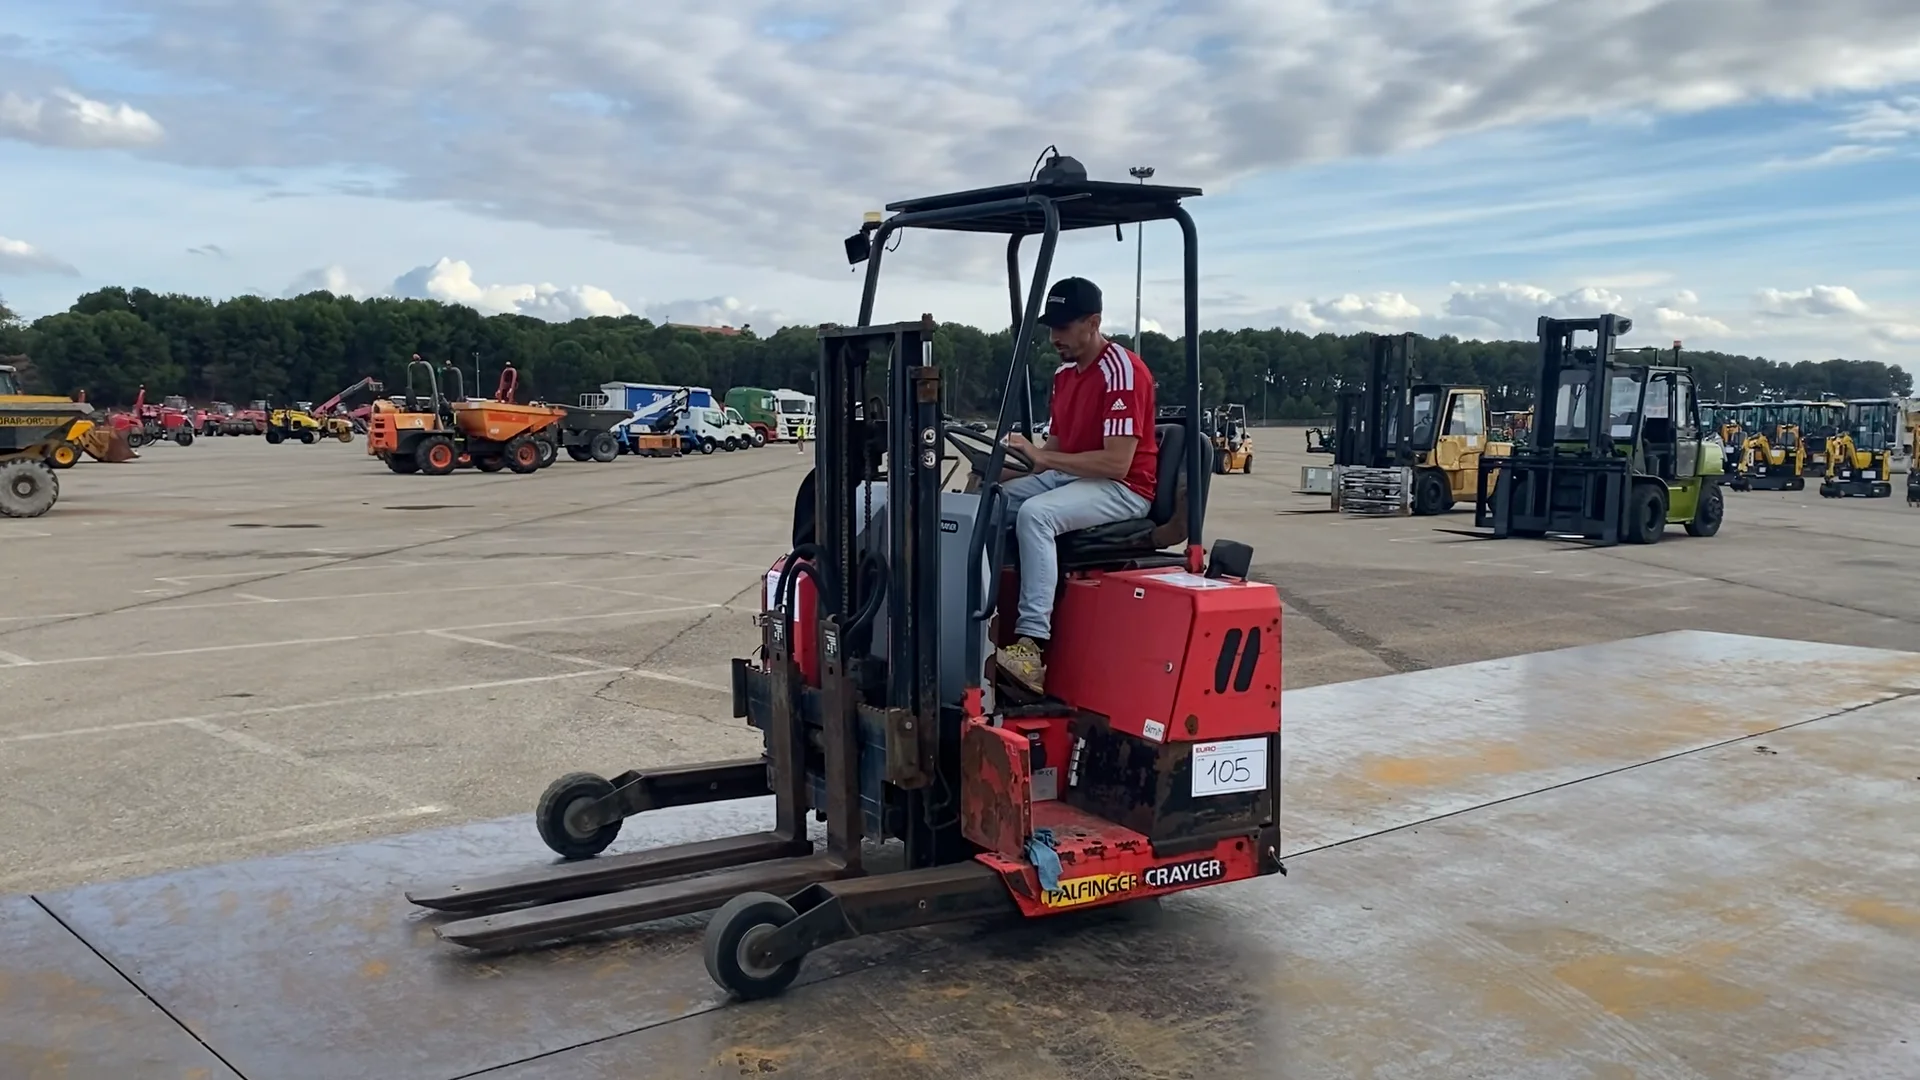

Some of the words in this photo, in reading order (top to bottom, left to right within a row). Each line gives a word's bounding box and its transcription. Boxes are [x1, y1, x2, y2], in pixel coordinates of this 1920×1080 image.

[1195, 745, 1217, 753] EURO
[1207, 756, 1251, 786] 105
[1048, 873, 1139, 904] PALFINGER
[1145, 859, 1221, 886] CRAYLER
